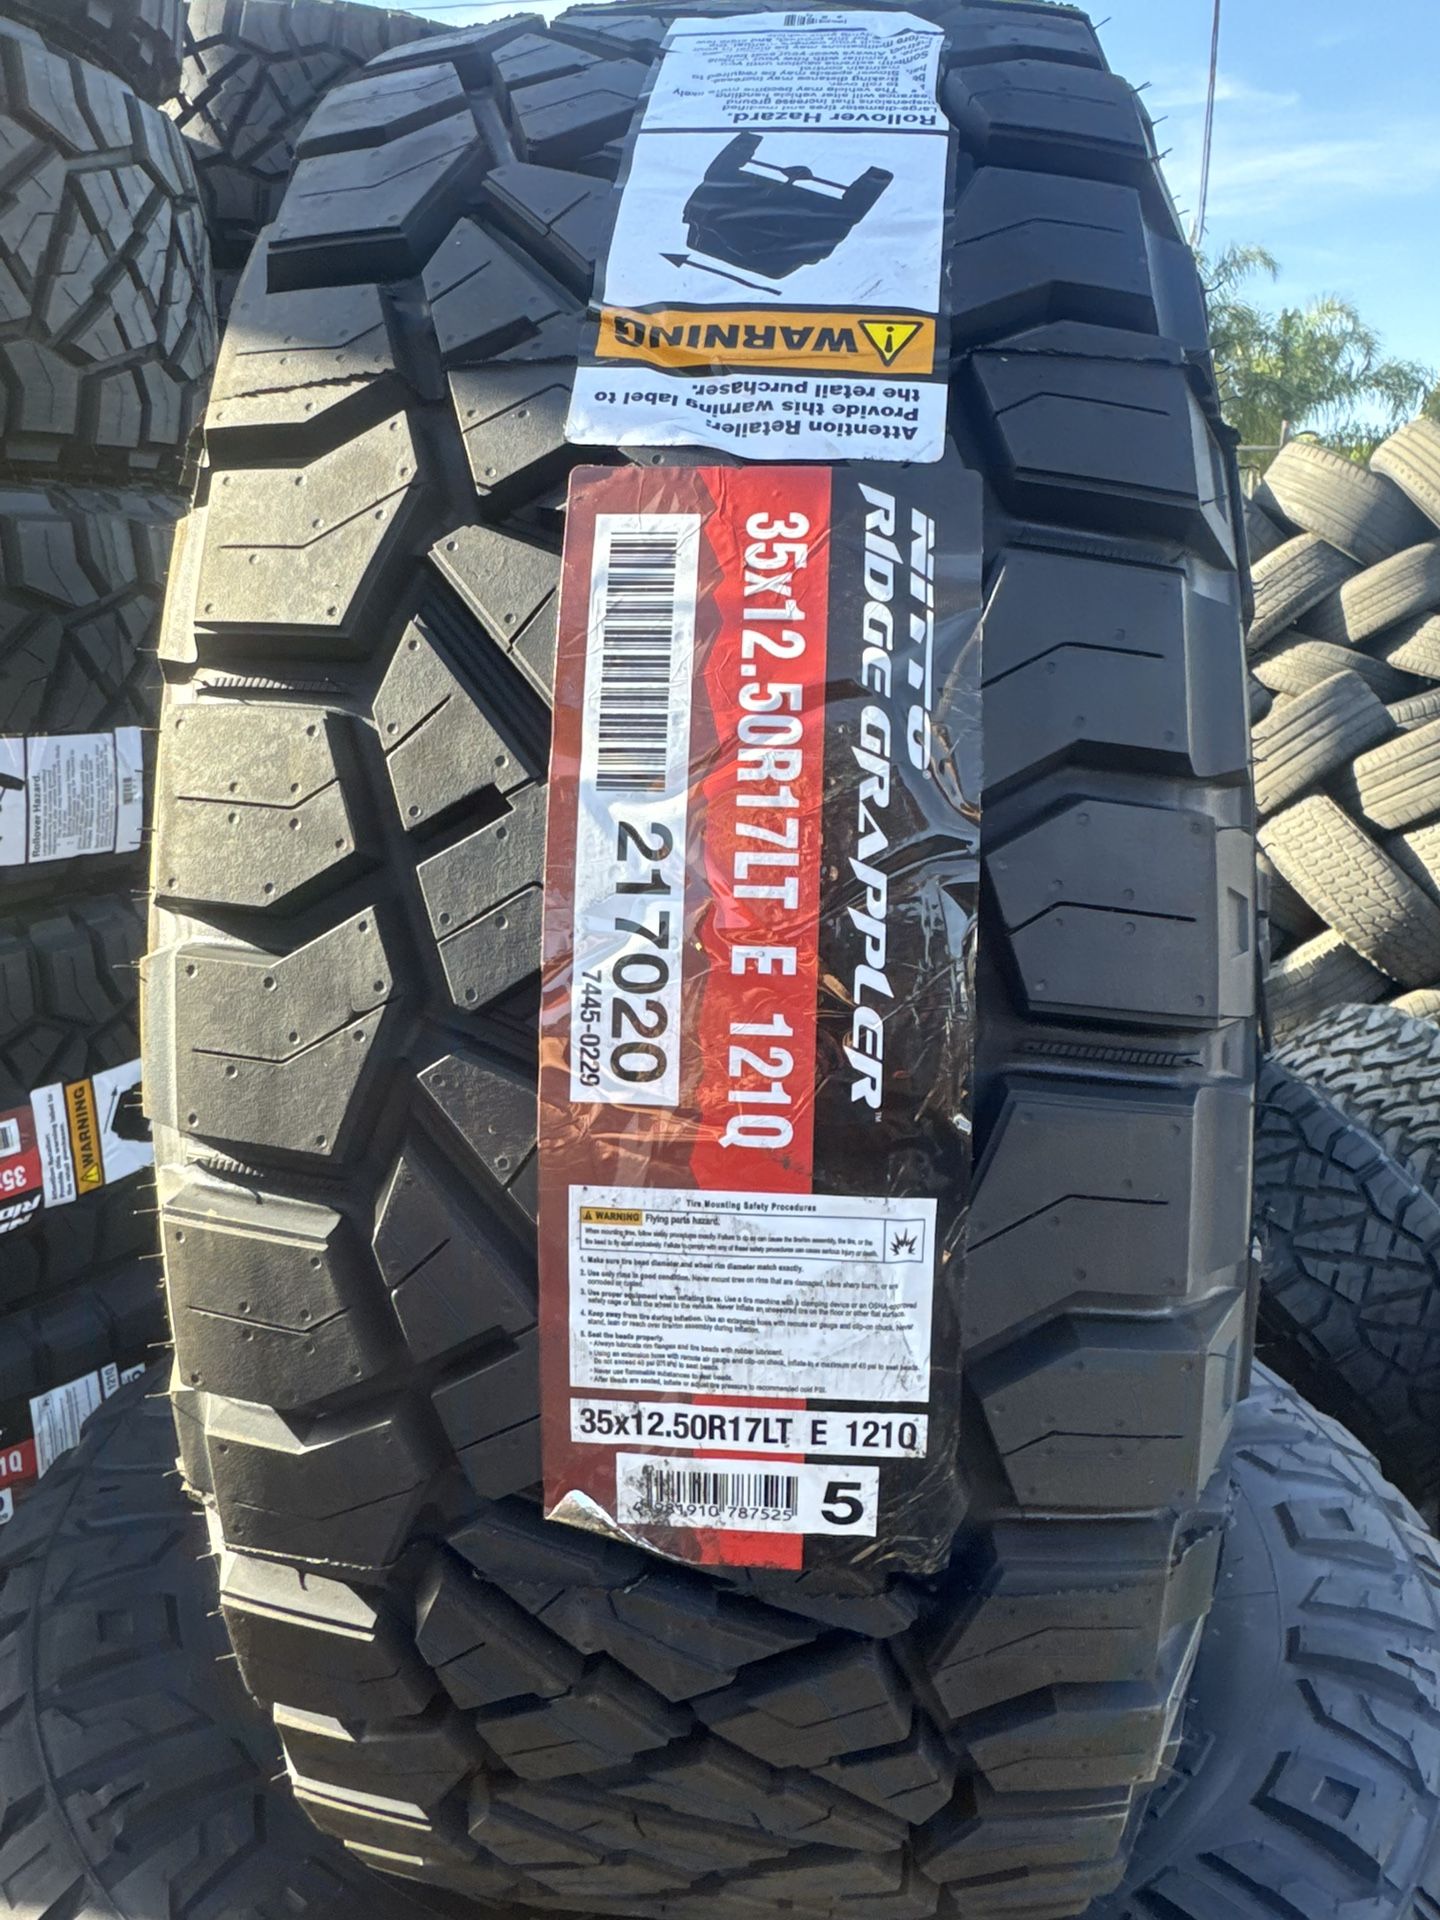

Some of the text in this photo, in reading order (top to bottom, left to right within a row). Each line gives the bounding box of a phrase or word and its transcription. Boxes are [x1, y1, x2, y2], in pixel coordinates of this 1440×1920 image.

[728, 112, 936, 126] Rollover Hazard.
[614, 316, 859, 353] WARNING
[594, 392, 919, 421] Provide this warning label to
[692, 381, 920, 402] the retail purchaser.
[706, 419, 918, 440] Attention Retailer:
[906, 508, 934, 770] NITTO
[843, 482, 904, 1110] RIDGE GRAPPLER
[32, 815, 41, 858] Rollover
[718, 512, 810, 1149] 35x12.50R17LT E 121Q
[610, 821, 674, 1082] 217020
[579, 970, 602, 1086] 7445-0229
[74, 1086, 93, 1168] WARNING
[0, 1166, 26, 1192] 35
[595, 1211, 639, 1221] WARNING
[645, 1213, 668, 1225] Flying
[671, 1215, 690, 1226] parts
[687, 1200, 816, 1212] Tire Mounting Safety Procedures
[580, 1408, 917, 1451] 35x12.50R17LT E 121Q
[728, 1506, 792, 1521] 787525
[821, 1481, 864, 1525] 5
